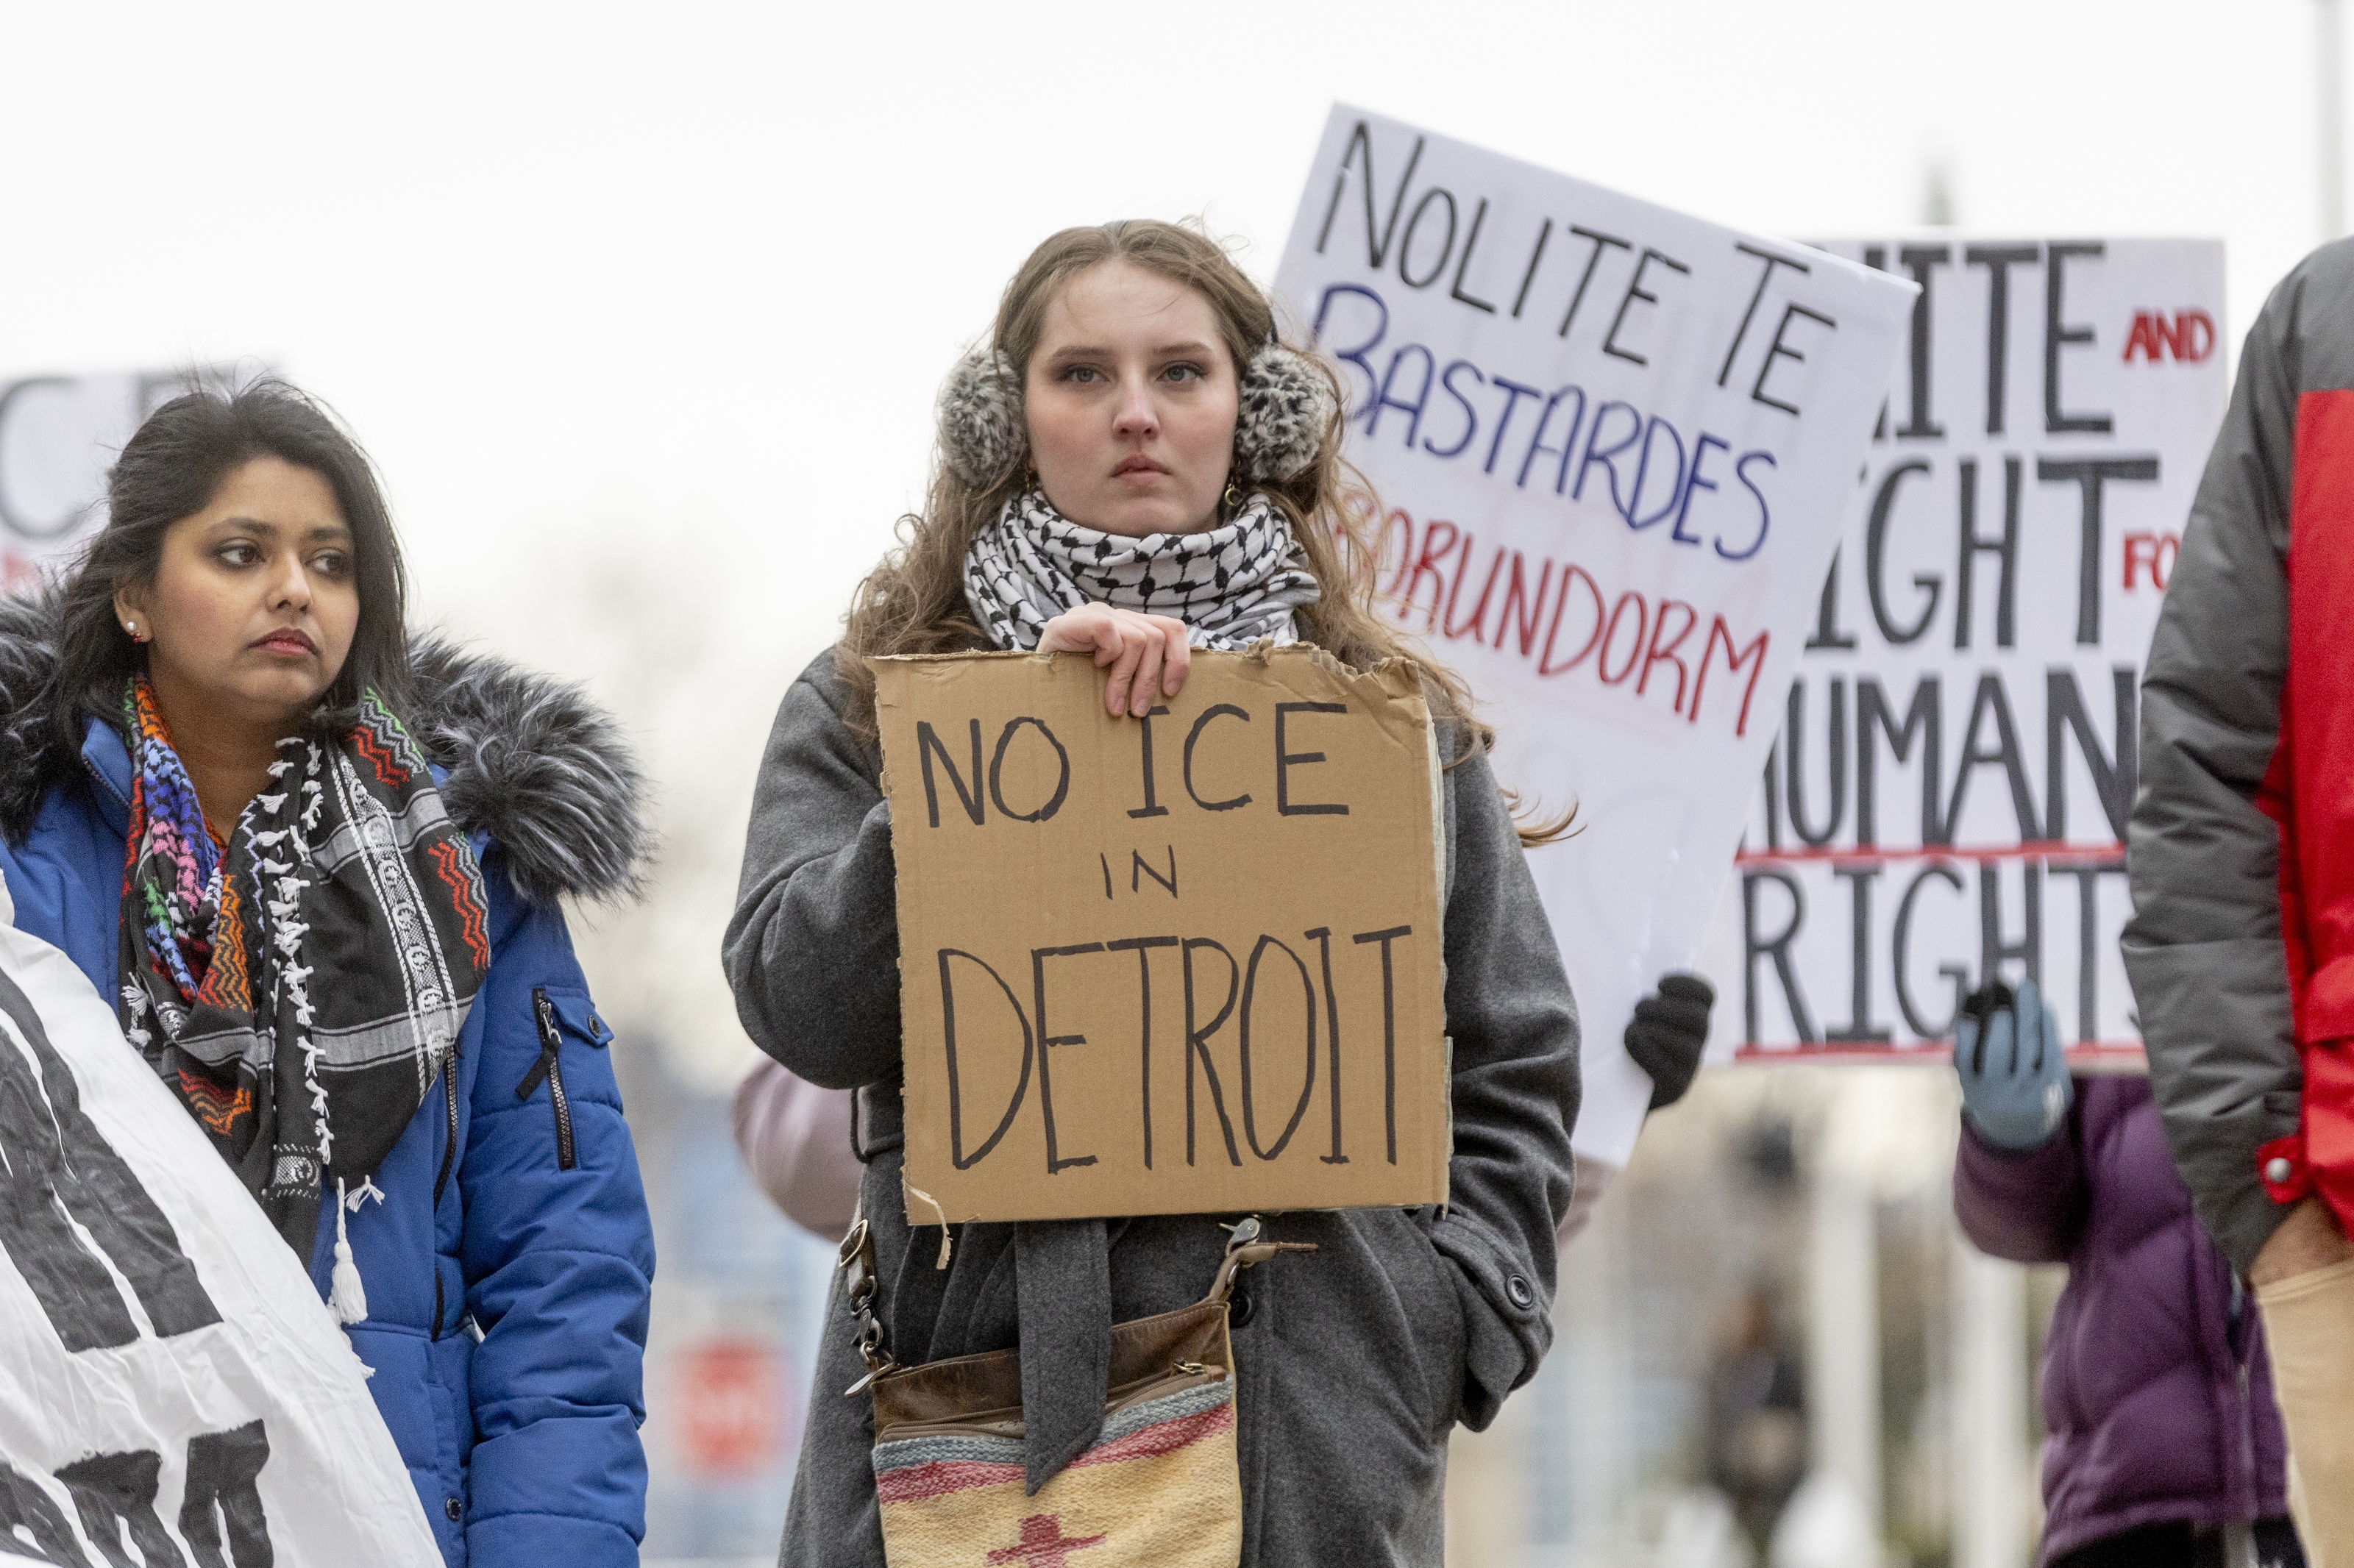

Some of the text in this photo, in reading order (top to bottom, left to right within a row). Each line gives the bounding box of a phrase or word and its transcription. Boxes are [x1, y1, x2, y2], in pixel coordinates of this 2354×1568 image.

[1315, 118, 1838, 418] NOLITE TE
[1865, 243, 2216, 443] ITE AND
[1306, 281, 1778, 562] BASTARDES
[917, 702, 1351, 828] NO ICE
[1099, 844, 1178, 900] IN
[1742, 862, 2139, 1043] RIGHT
[937, 924, 1413, 1175] DETROIT
